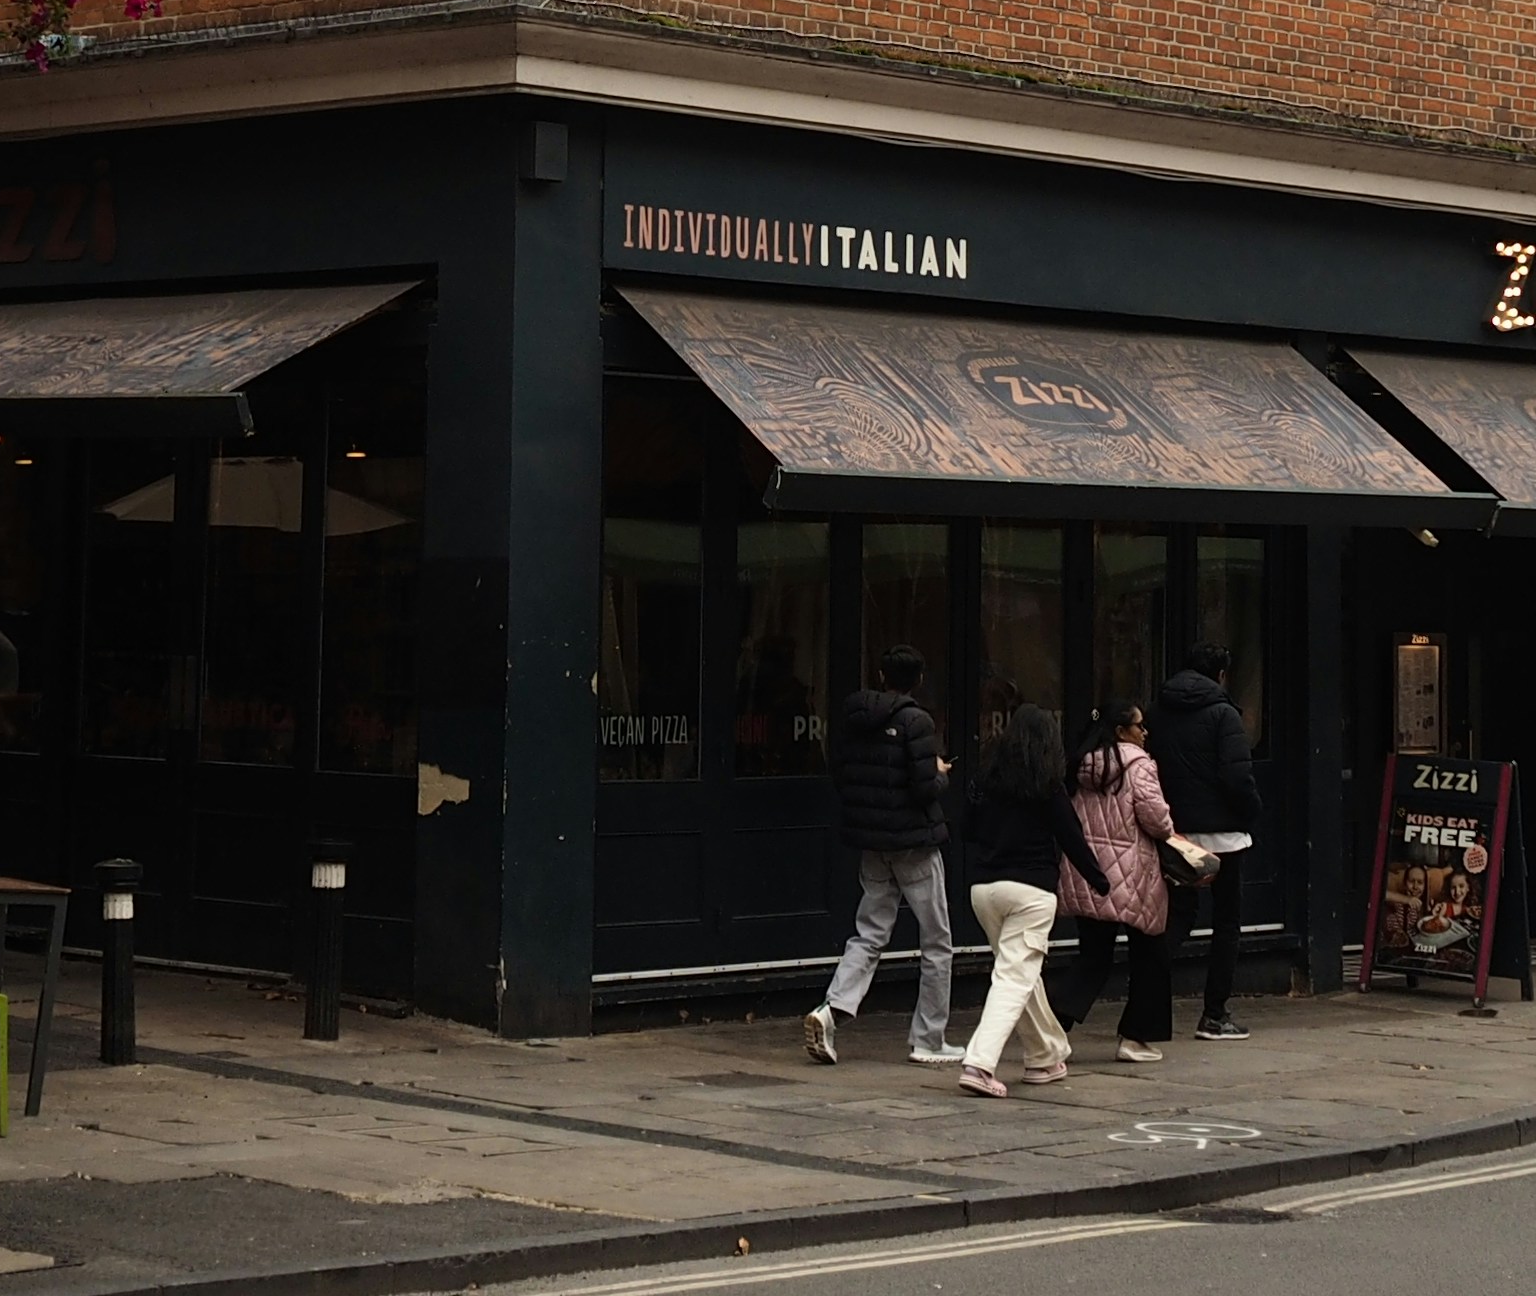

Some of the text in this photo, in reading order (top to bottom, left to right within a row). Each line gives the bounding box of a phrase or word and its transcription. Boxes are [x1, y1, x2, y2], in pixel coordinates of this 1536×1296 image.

[993, 375, 1109, 414] Zizzi
[651, 714, 689, 745] PIZZA
[1412, 763, 1479, 794] Zizzi
[1406, 813, 1479, 830] KIDS EAT
[1403, 824, 1477, 849] FREE
[1414, 942, 1438, 955] Zizzi
